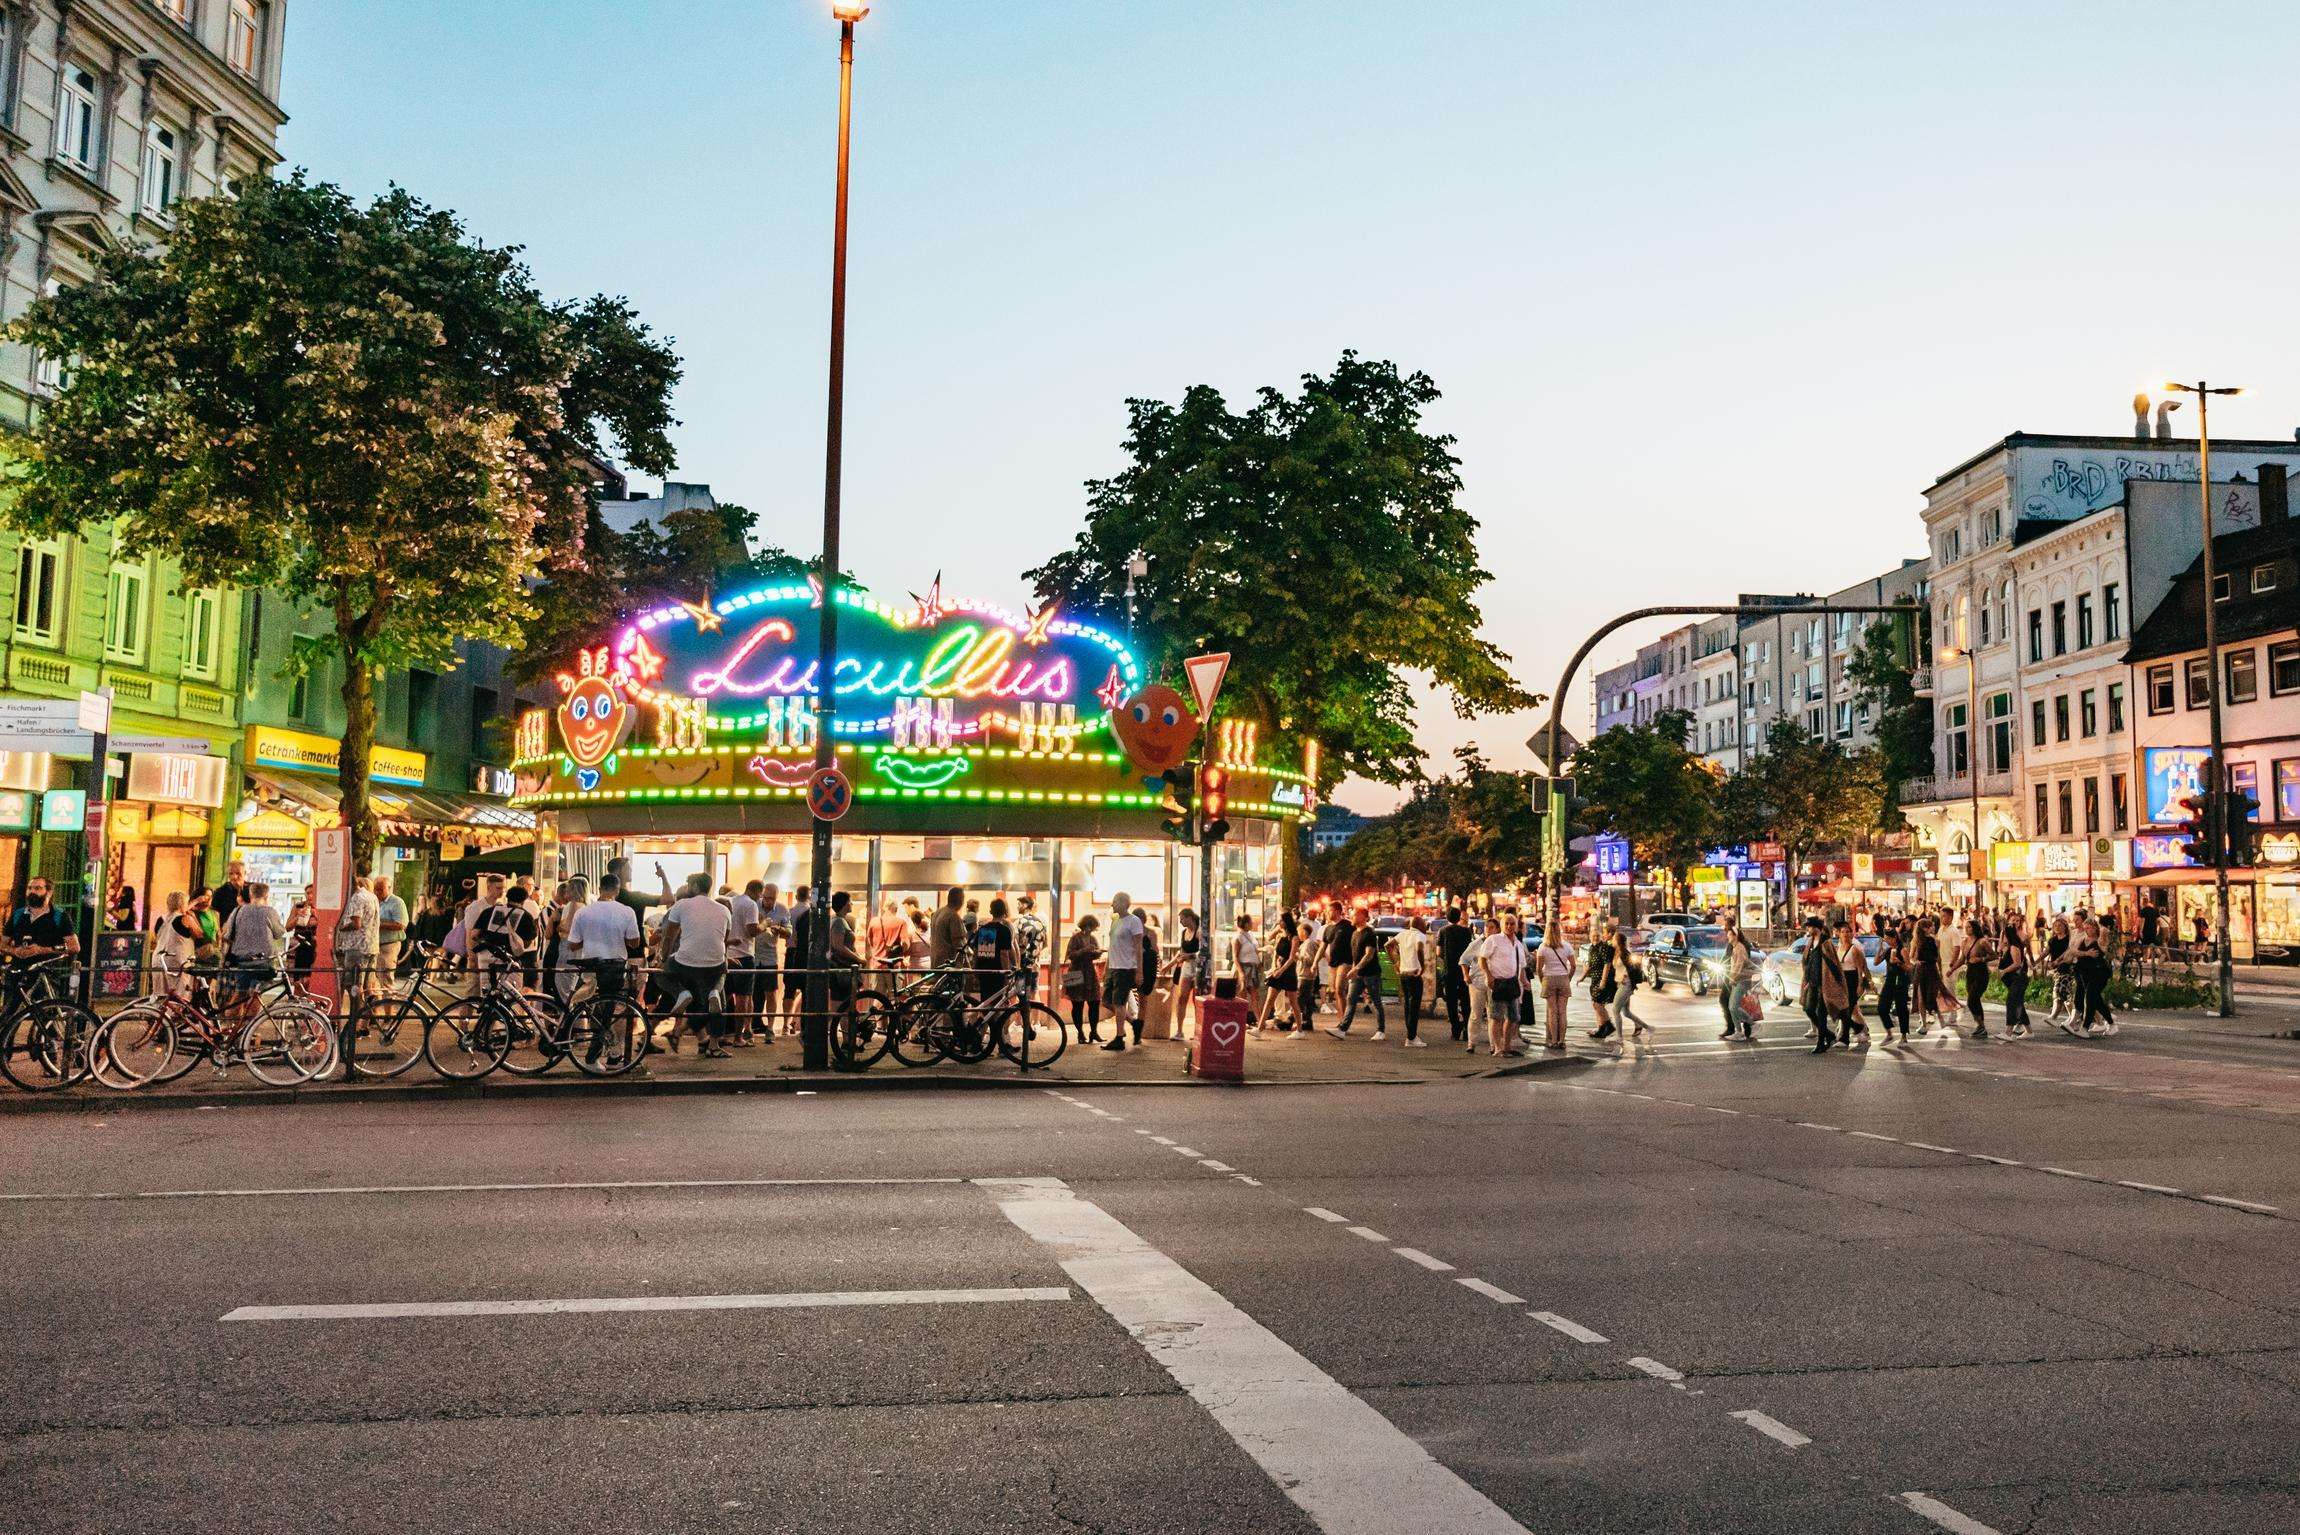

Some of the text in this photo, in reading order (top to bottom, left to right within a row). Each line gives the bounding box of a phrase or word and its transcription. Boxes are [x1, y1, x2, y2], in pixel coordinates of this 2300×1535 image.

[692, 620, 1068, 698] Lucullus
[111, 740, 165, 748] Schanzenviertel
[1911, 859, 1929, 872] KFC
